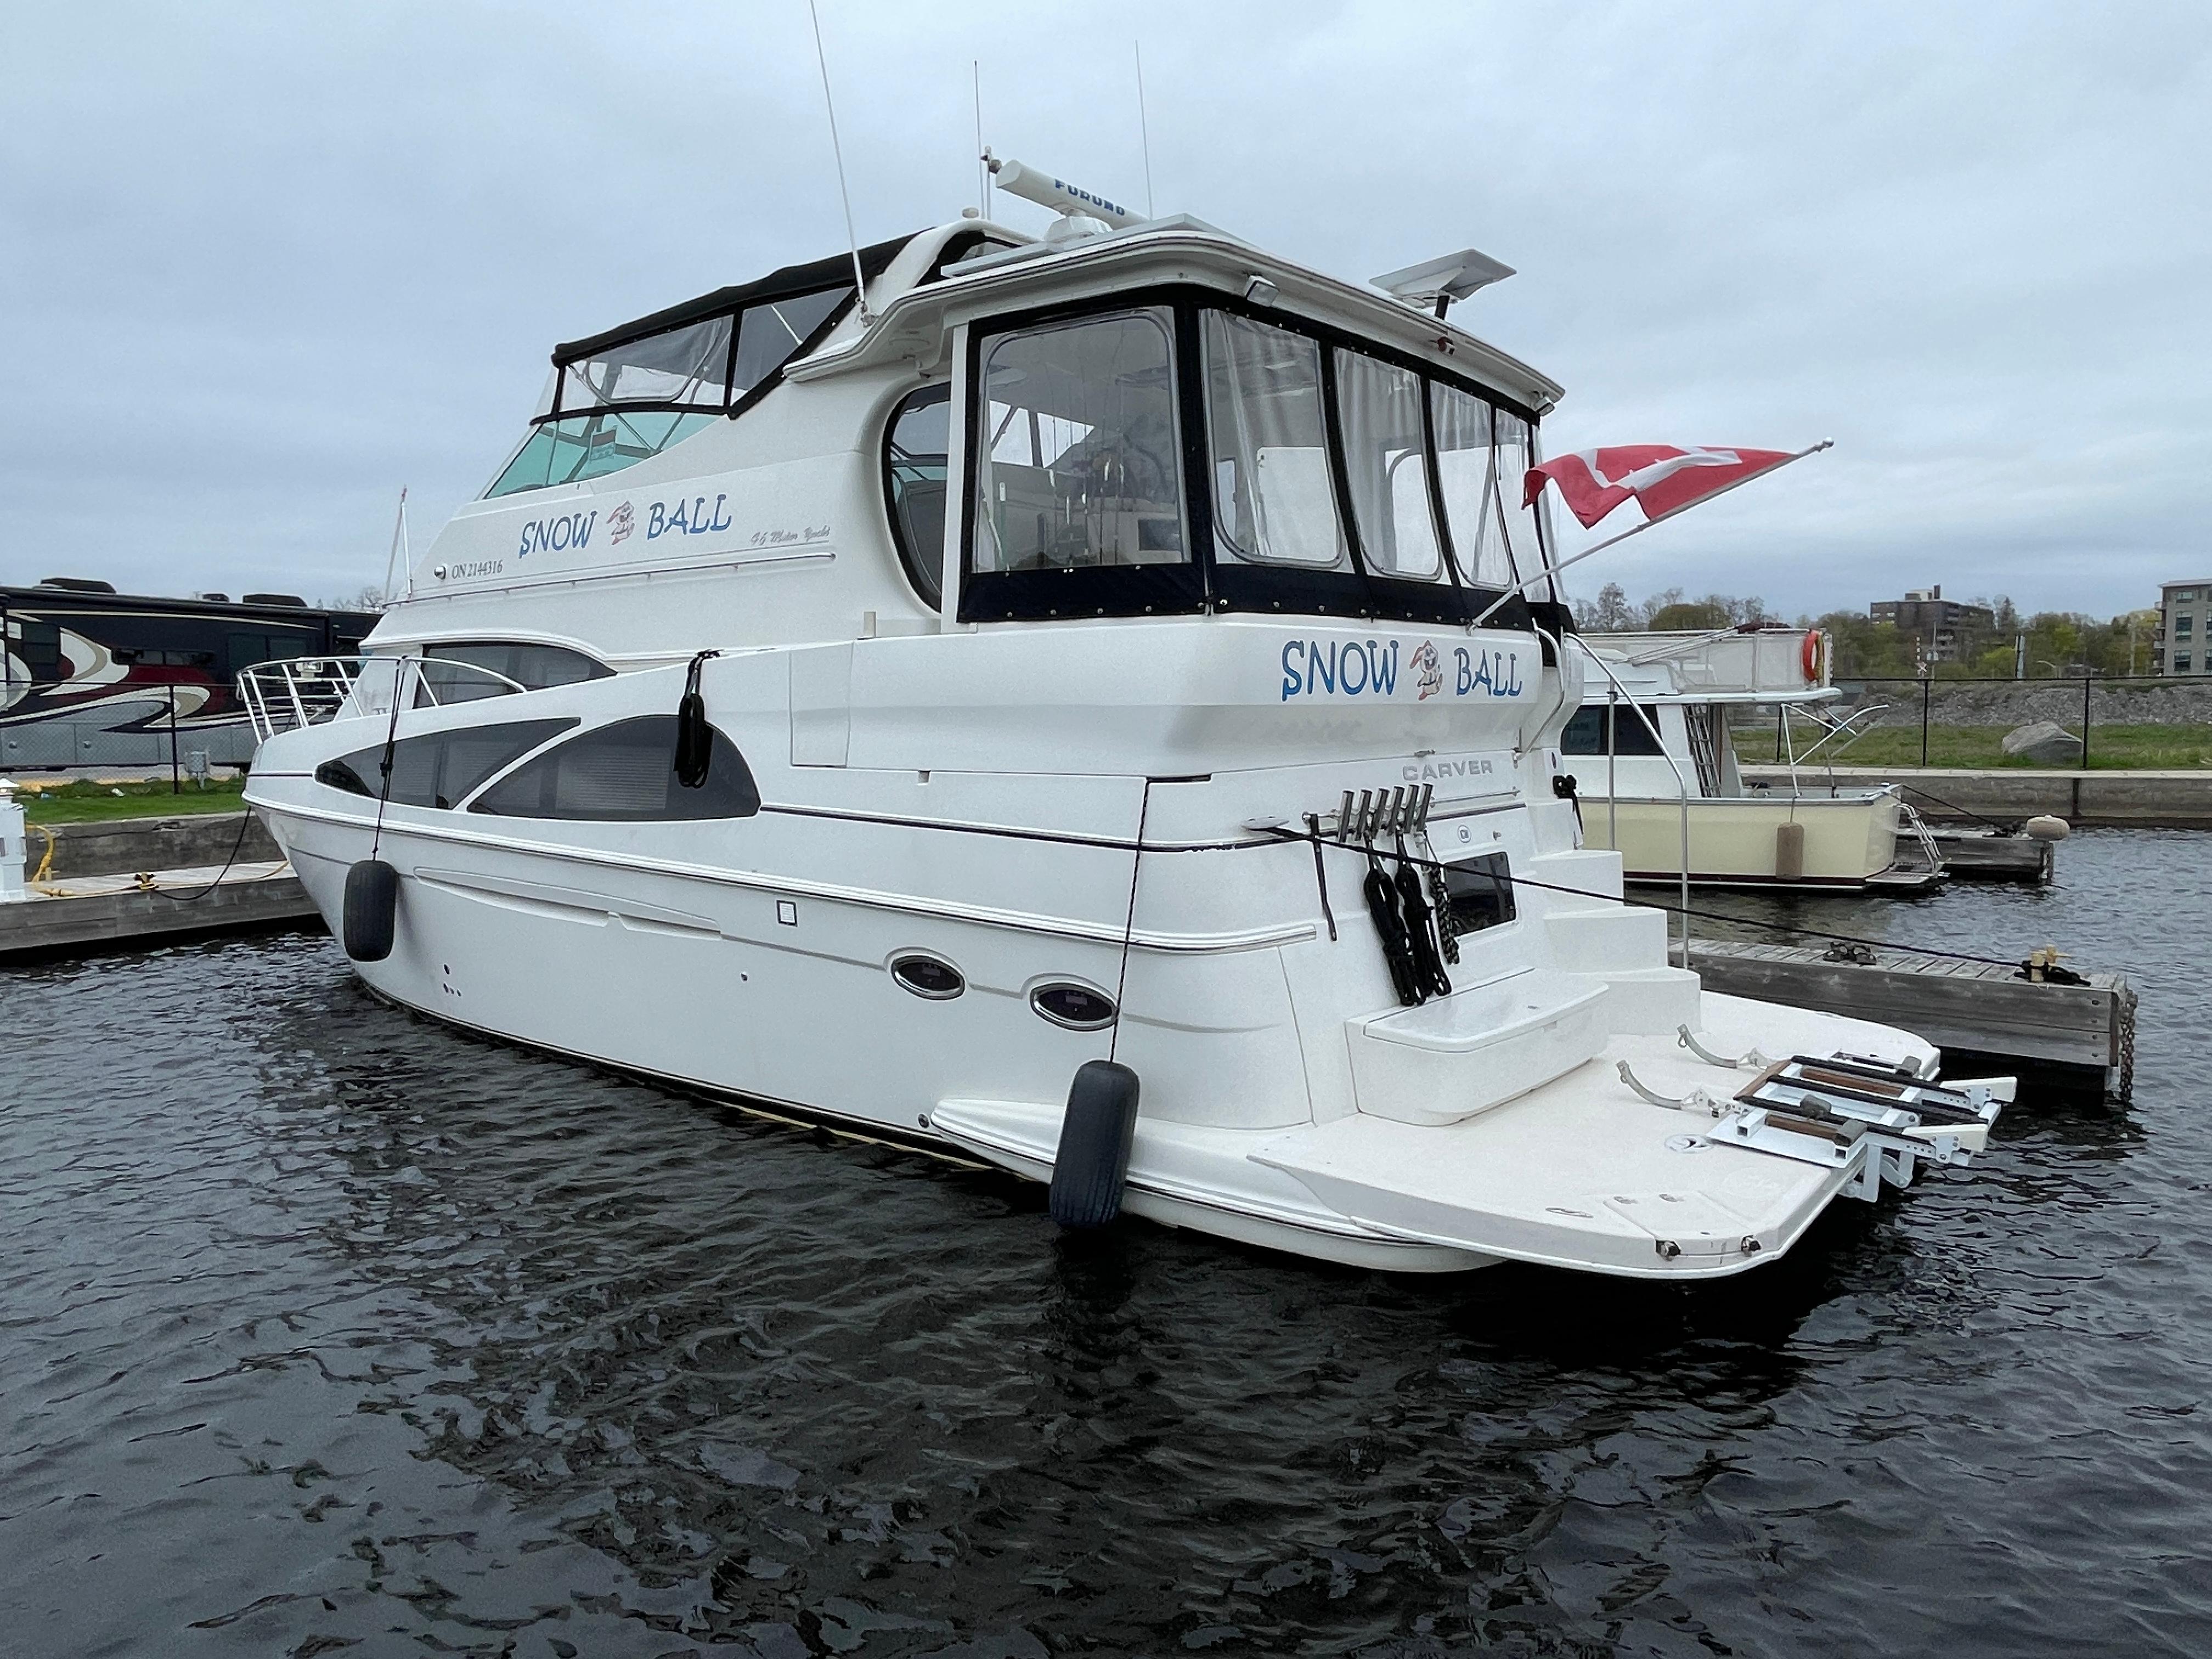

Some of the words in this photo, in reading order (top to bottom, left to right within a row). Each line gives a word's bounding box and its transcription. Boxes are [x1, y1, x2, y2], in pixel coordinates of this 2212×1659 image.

[1054, 179, 1125, 216] FURUNO
[519, 510, 597, 559] SNOW
[647, 494, 732, 540] BALL
[1282, 640, 1399, 702] SNOW
[1454, 647, 1523, 697] BALL
[1402, 760, 1493, 781] CARVER
